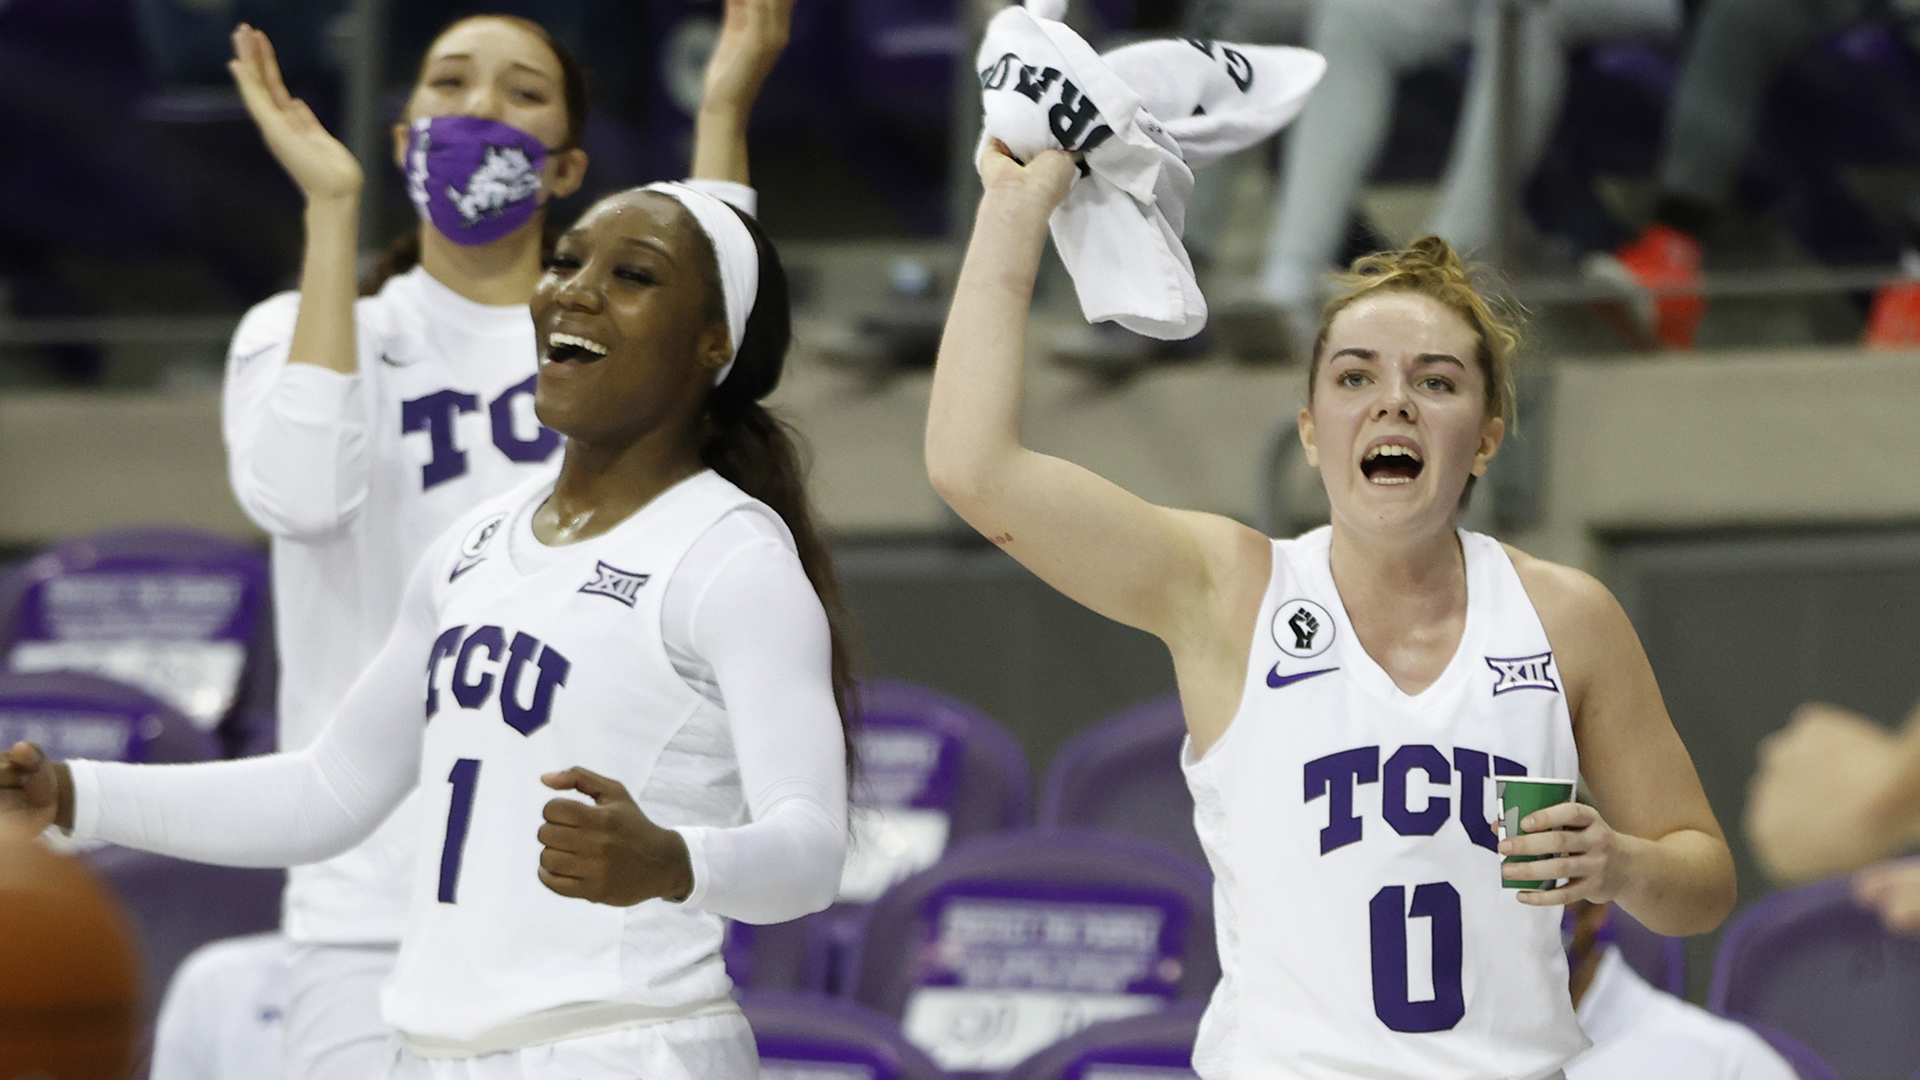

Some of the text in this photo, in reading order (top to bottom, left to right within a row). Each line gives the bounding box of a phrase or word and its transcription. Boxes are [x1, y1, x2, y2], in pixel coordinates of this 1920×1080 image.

[402, 374, 560, 490] TC
[578, 559, 651, 608] XII
[1484, 651, 1559, 697] XII
[438, 758, 482, 904] 1
[1303, 744, 1528, 857] TCU
[1369, 881, 1465, 1033] 0
